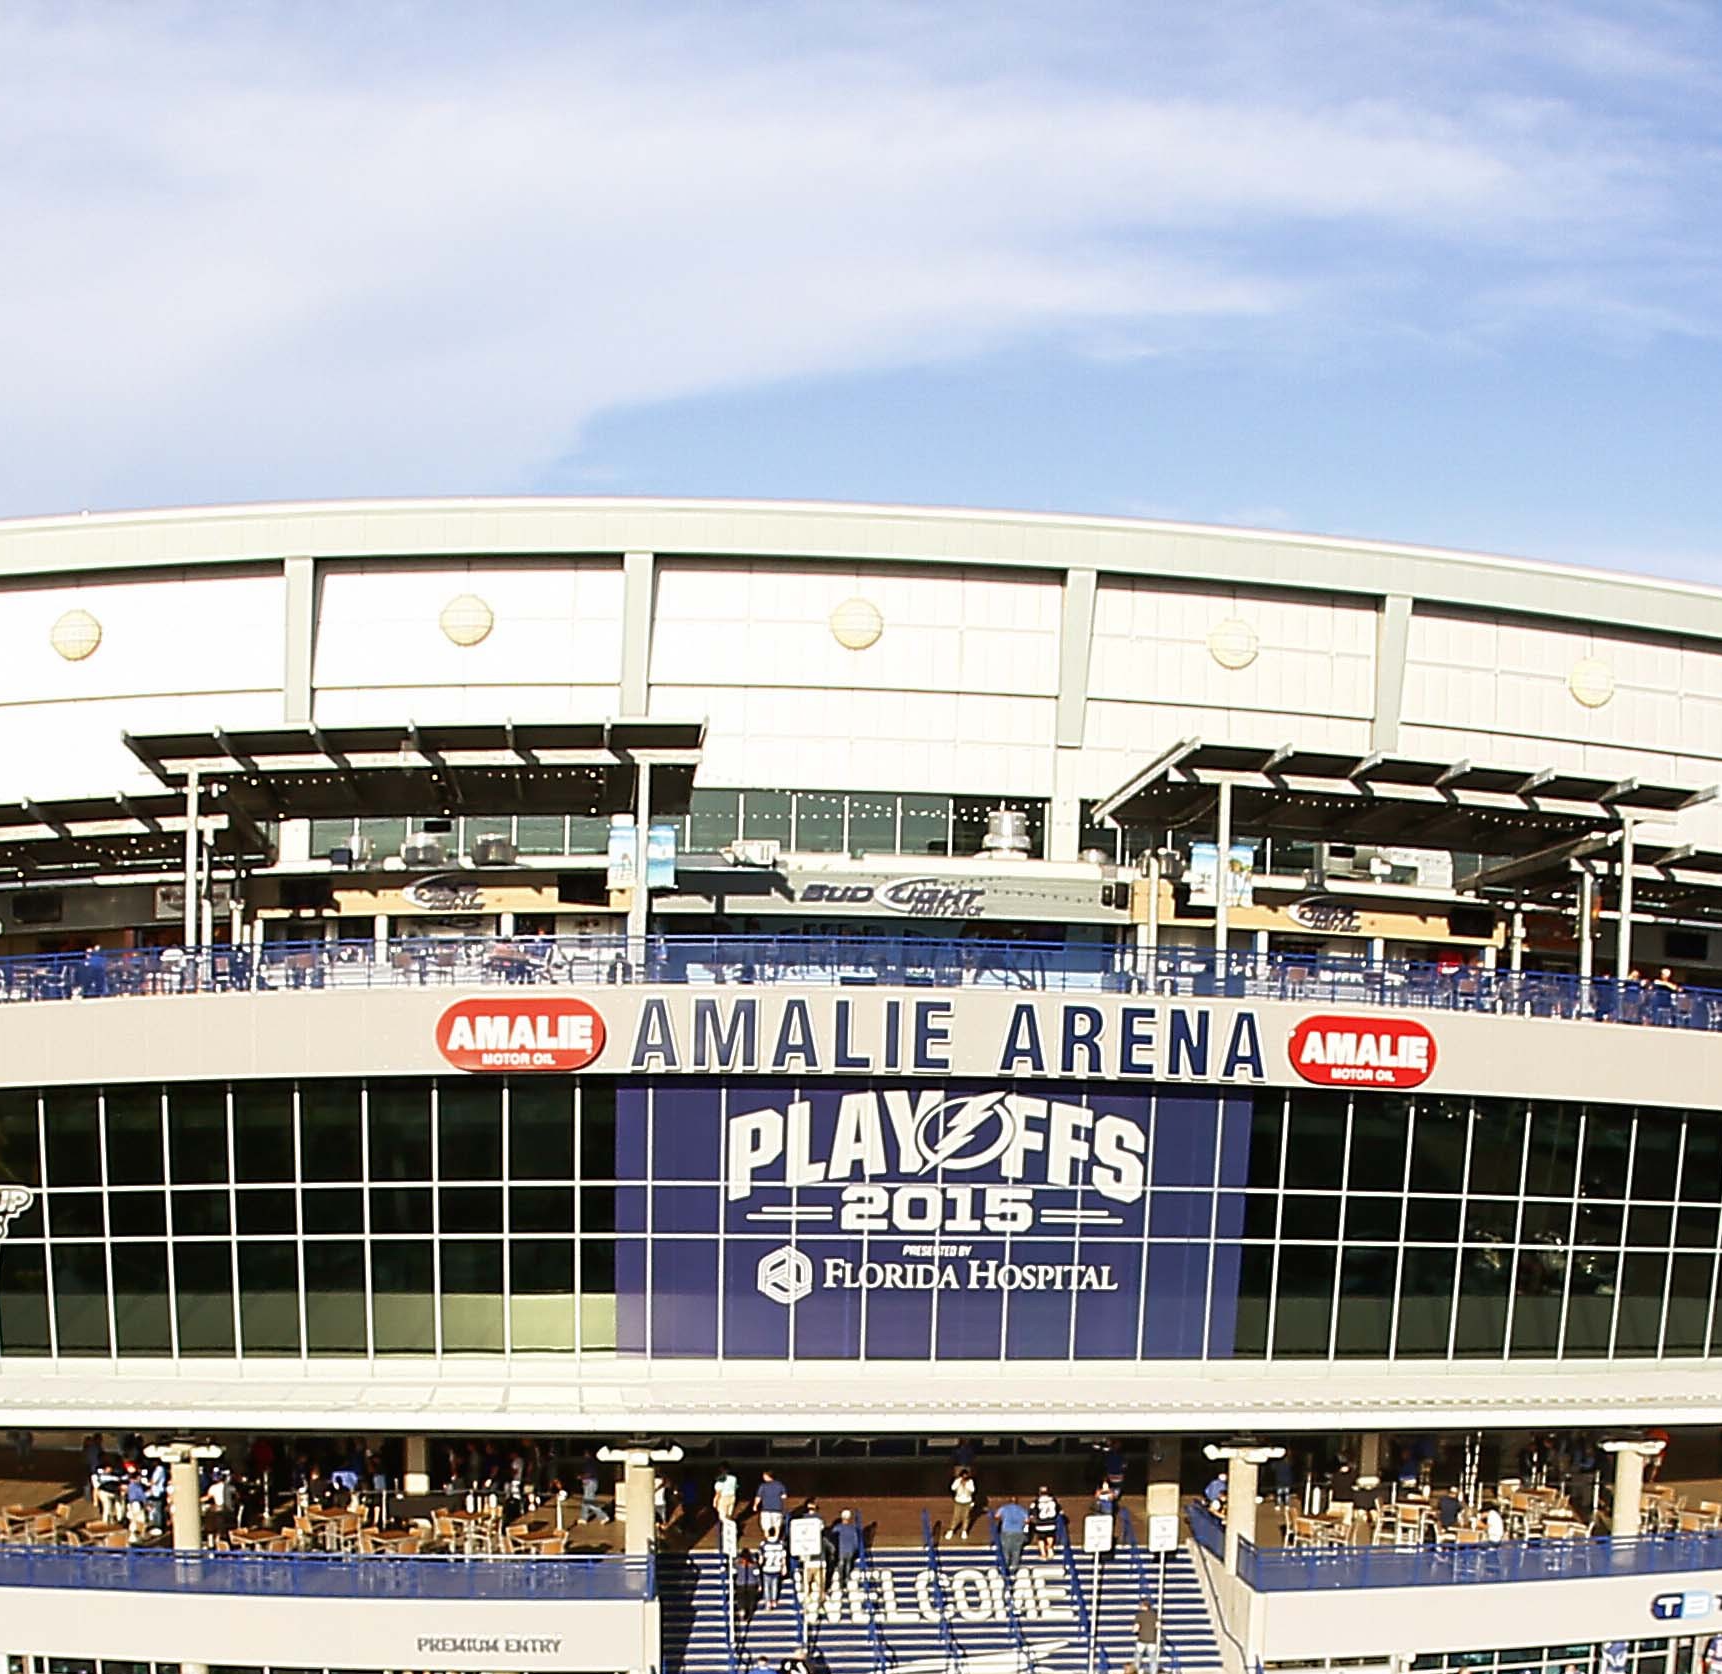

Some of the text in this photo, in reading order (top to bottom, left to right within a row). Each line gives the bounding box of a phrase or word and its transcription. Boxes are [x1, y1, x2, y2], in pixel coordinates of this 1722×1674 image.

[801, 885, 874, 902] BUD
[446, 1014, 593, 1051] AMALIE
[630, 997, 1268, 1083] AMALIE ARENA
[1300, 1031, 1429, 1069] AMALIE
[481, 1053, 556, 1065] MOTOR OIL
[1330, 1068, 1396, 1083] MOTOR OIL
[728, 1090, 1146, 1203] PLAYOFFS
[840, 1185, 1034, 1232] 2015
[823, 1258, 1118, 1291] FLORIDA HOSPITAL
[793, 1567, 1075, 1624] WELCOME
[416, 1637, 563, 1654] PREMIUM ENTRY
